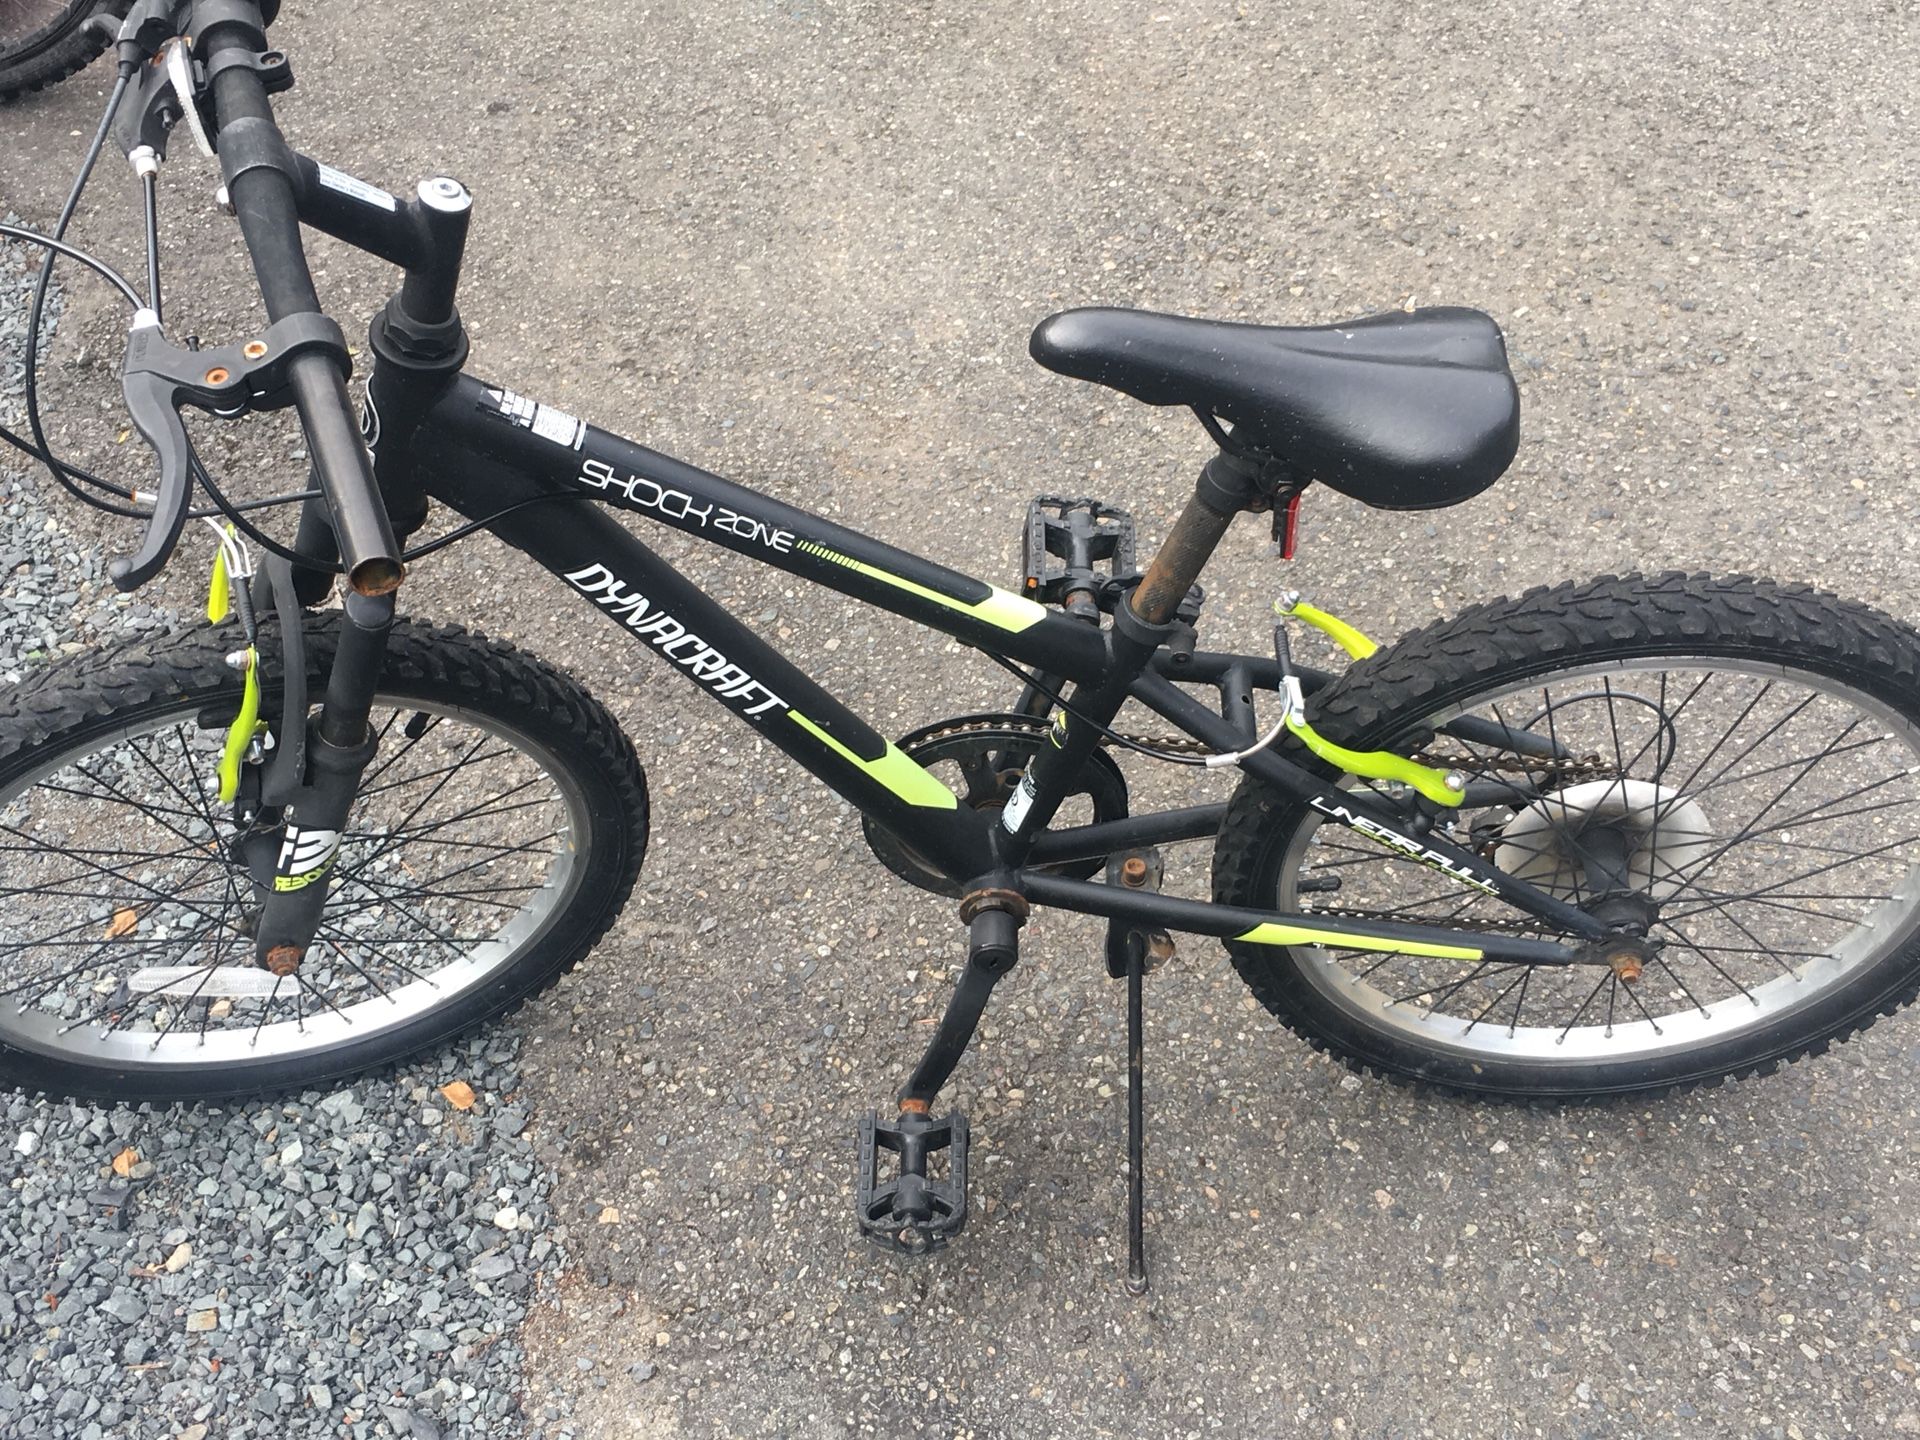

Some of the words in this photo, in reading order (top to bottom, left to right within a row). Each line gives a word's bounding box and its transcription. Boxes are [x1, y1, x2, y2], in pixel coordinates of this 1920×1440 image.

[578, 459, 713, 526] SHOCK
[714, 508, 795, 553] ZONE
[564, 563, 790, 715] DYNACRAFT
[1310, 796, 1423, 853] LINEAR
[1420, 850, 1499, 895] PULL
